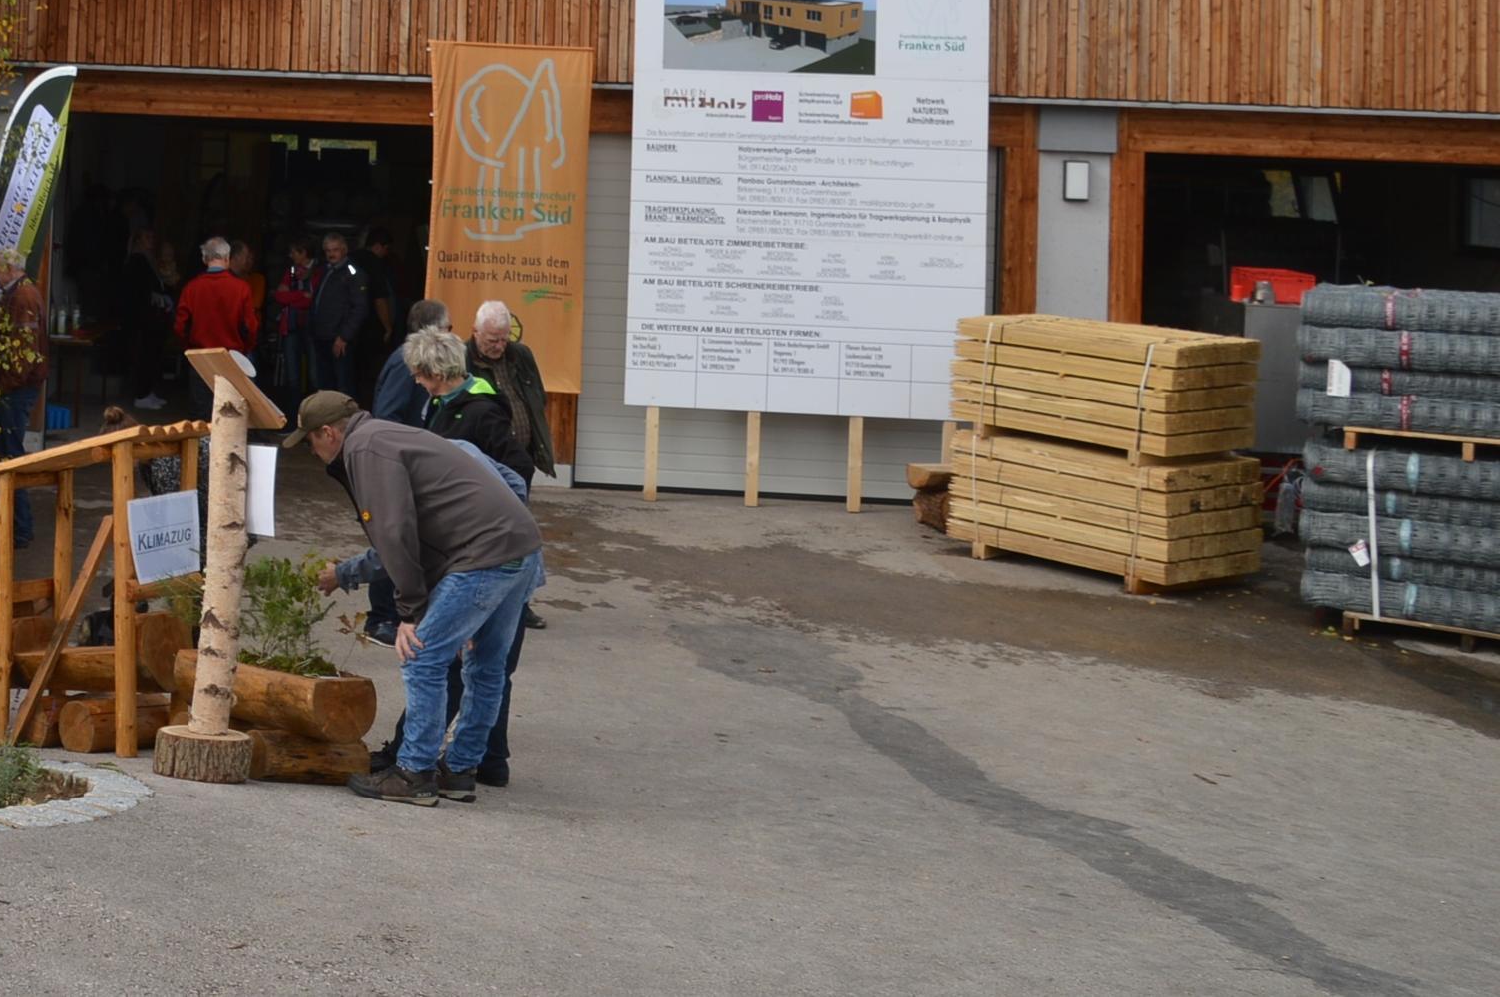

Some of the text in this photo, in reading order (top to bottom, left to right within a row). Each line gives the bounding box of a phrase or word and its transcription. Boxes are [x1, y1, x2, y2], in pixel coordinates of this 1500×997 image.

[898, 40, 965, 51] Franken Süd
[442, 199, 572, 224] Franken Süd
[644, 236, 657, 244] AM
[658, 237, 676, 245] BAU
[678, 237, 724, 247] BETEILIGTE
[437, 250, 570, 269] Qualitätsholz aus dem
[438, 267, 568, 286] Naturpark Altmühltal
[676, 279, 723, 289] BETEILIGTE
[641, 323, 655, 331] DIE
[657, 324, 699, 333] WEITEREN
[715, 326, 732, 334] BAU
[734, 327, 787, 337] BETEILIGTEN
[137, 527, 192, 551] KLIMAZUG
